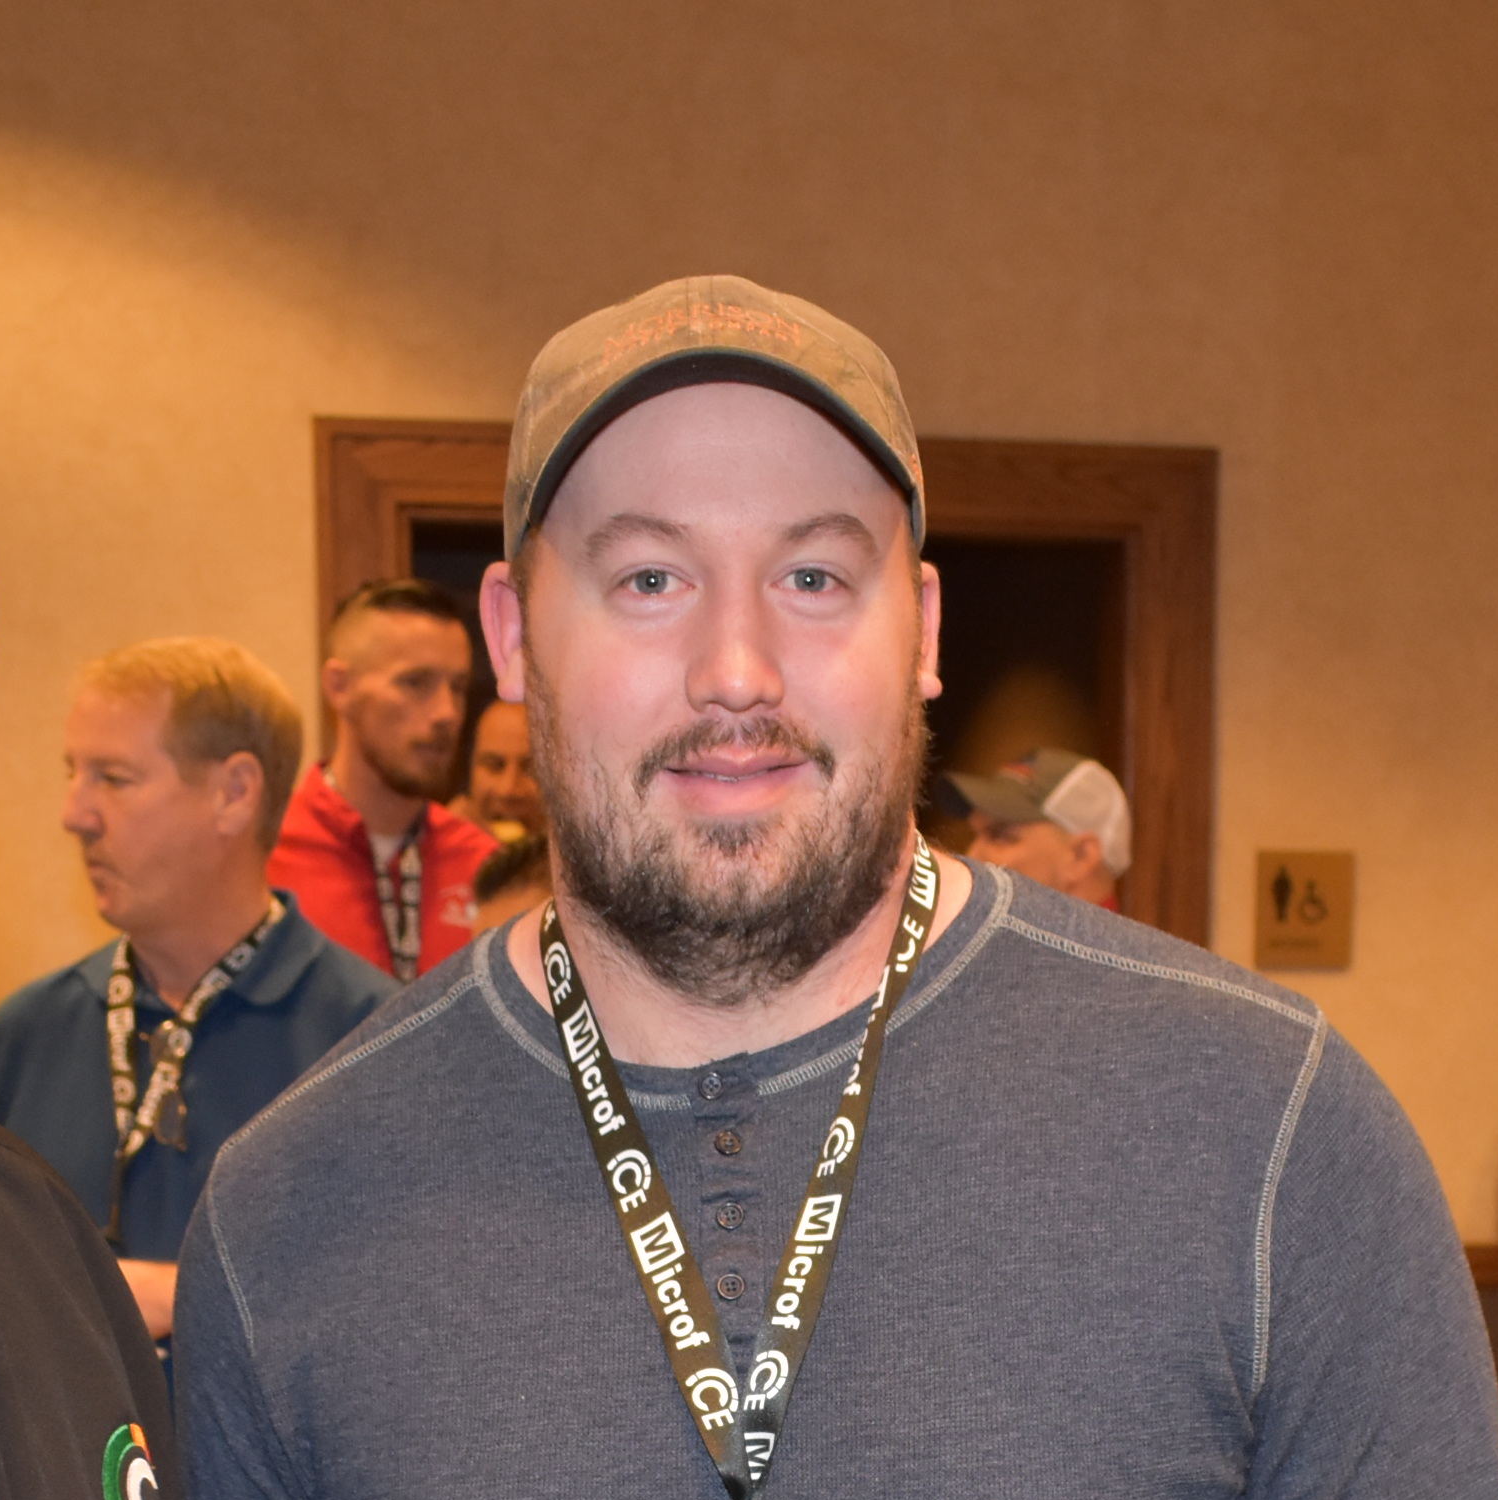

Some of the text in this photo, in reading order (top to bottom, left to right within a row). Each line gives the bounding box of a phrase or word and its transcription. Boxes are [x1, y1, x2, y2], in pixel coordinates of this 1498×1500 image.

[562, 1000, 626, 1136] Microf
[630, 1211, 710, 1350] Microf
[771, 1194, 843, 1330] Microf
